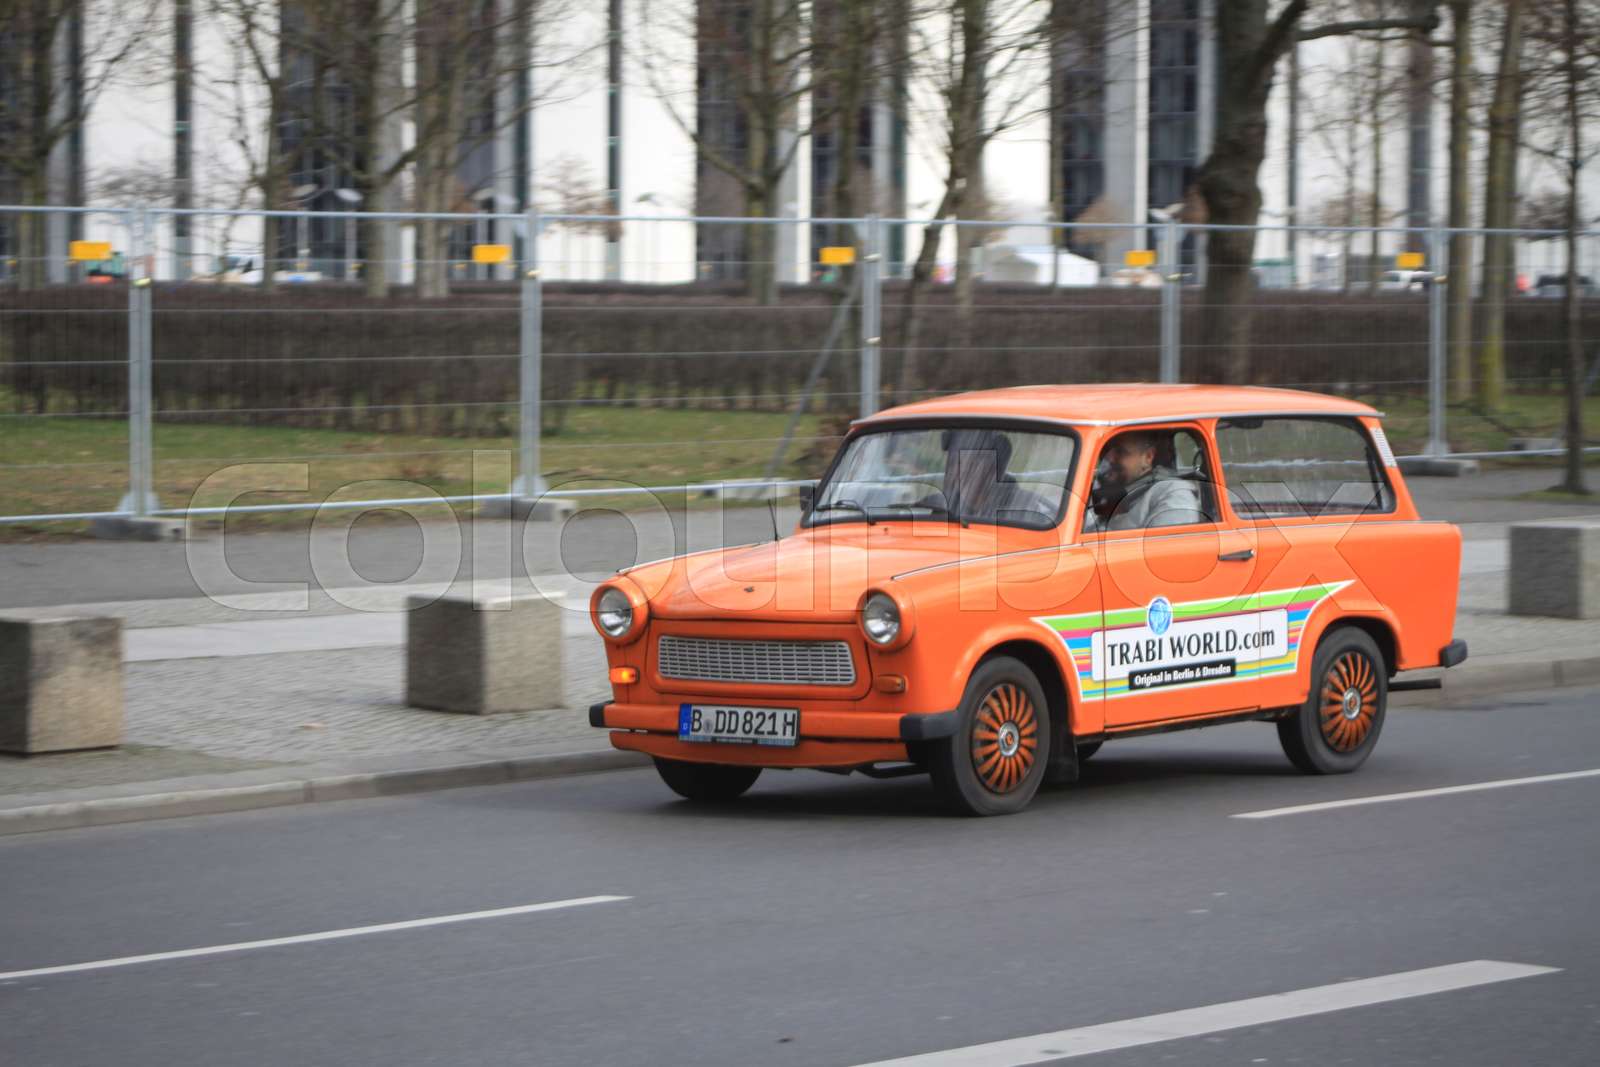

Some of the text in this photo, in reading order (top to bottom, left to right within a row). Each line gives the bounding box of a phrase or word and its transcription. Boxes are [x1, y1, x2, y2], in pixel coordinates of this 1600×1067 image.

[1107, 629, 1275, 666] TRABI WORLD.com
[1134, 664, 1231, 687] Original in Berlin & Dresden
[691, 709, 703, 733] B
